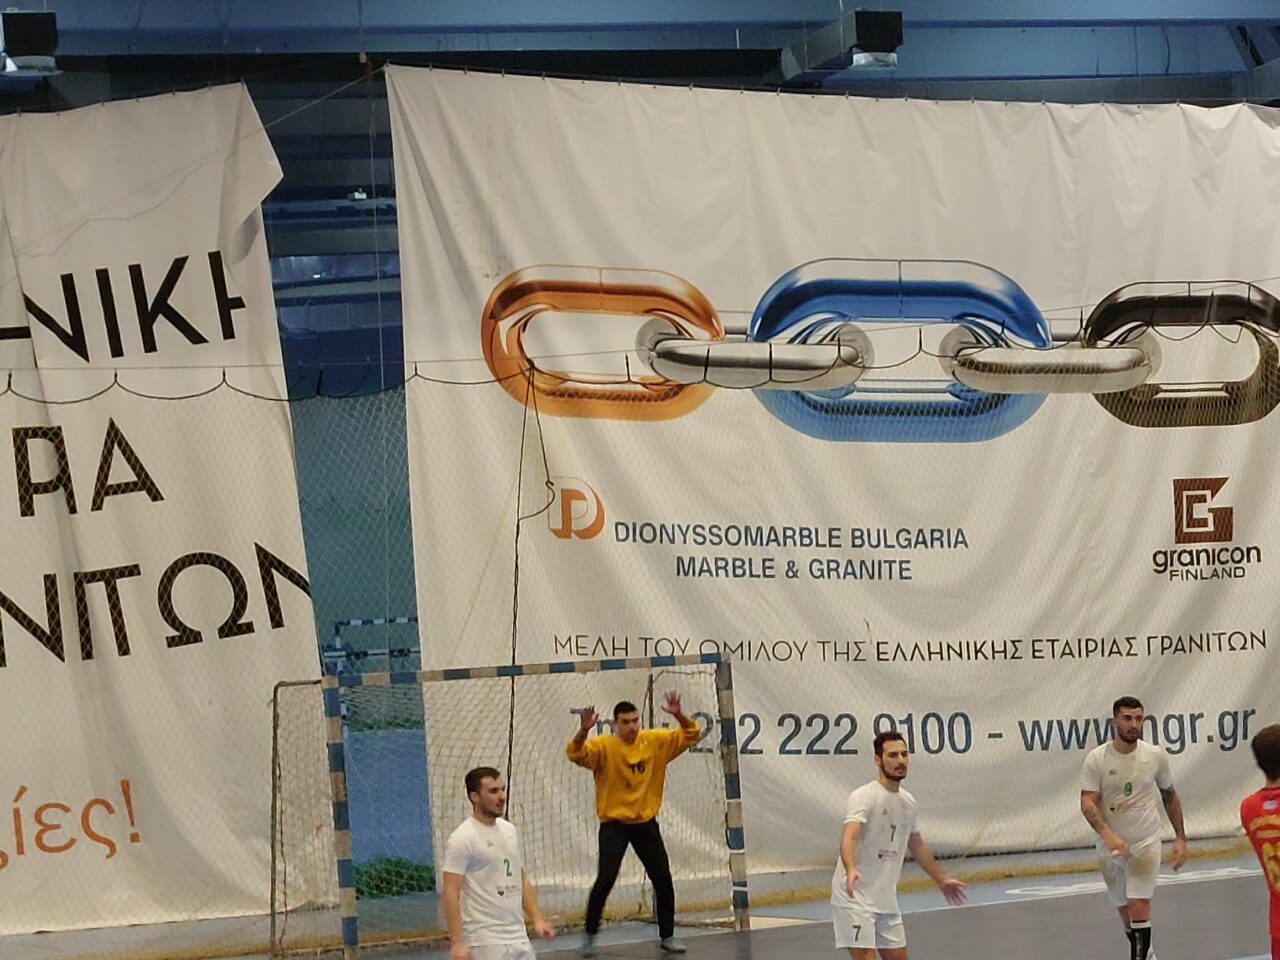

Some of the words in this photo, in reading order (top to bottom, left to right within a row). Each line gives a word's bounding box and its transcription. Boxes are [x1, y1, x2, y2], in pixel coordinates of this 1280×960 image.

[614, 522, 842, 548] DIONYSSOMARBLE
[851, 528, 969, 550] BULGARIA
[676, 556, 776, 579] MARBLE
[785, 561, 800, 579] &
[809, 559, 912, 581] GRANITE
[1152, 546, 1261, 574] granicon
[1169, 566, 1246, 581] FINLAND
[554, 634, 629, 657] ΜΕΛΗ
[817, 641, 868, 662] ΤΗΣ
[877, 639, 1023, 662] ΕΛΛΗΝΙΚΗΣ
[1032, 636, 1138, 660] ΕΤΑΙΡΙΑΣ
[1147, 629, 1267, 657] ΓΡΑΝΙΤΩΝ
[689, 712, 764, 755] 22
[777, 712, 859, 755] 222
[890, 825, 897, 842] 7
[503, 858, 512, 877] 2
[852, 925, 861, 942] 7
